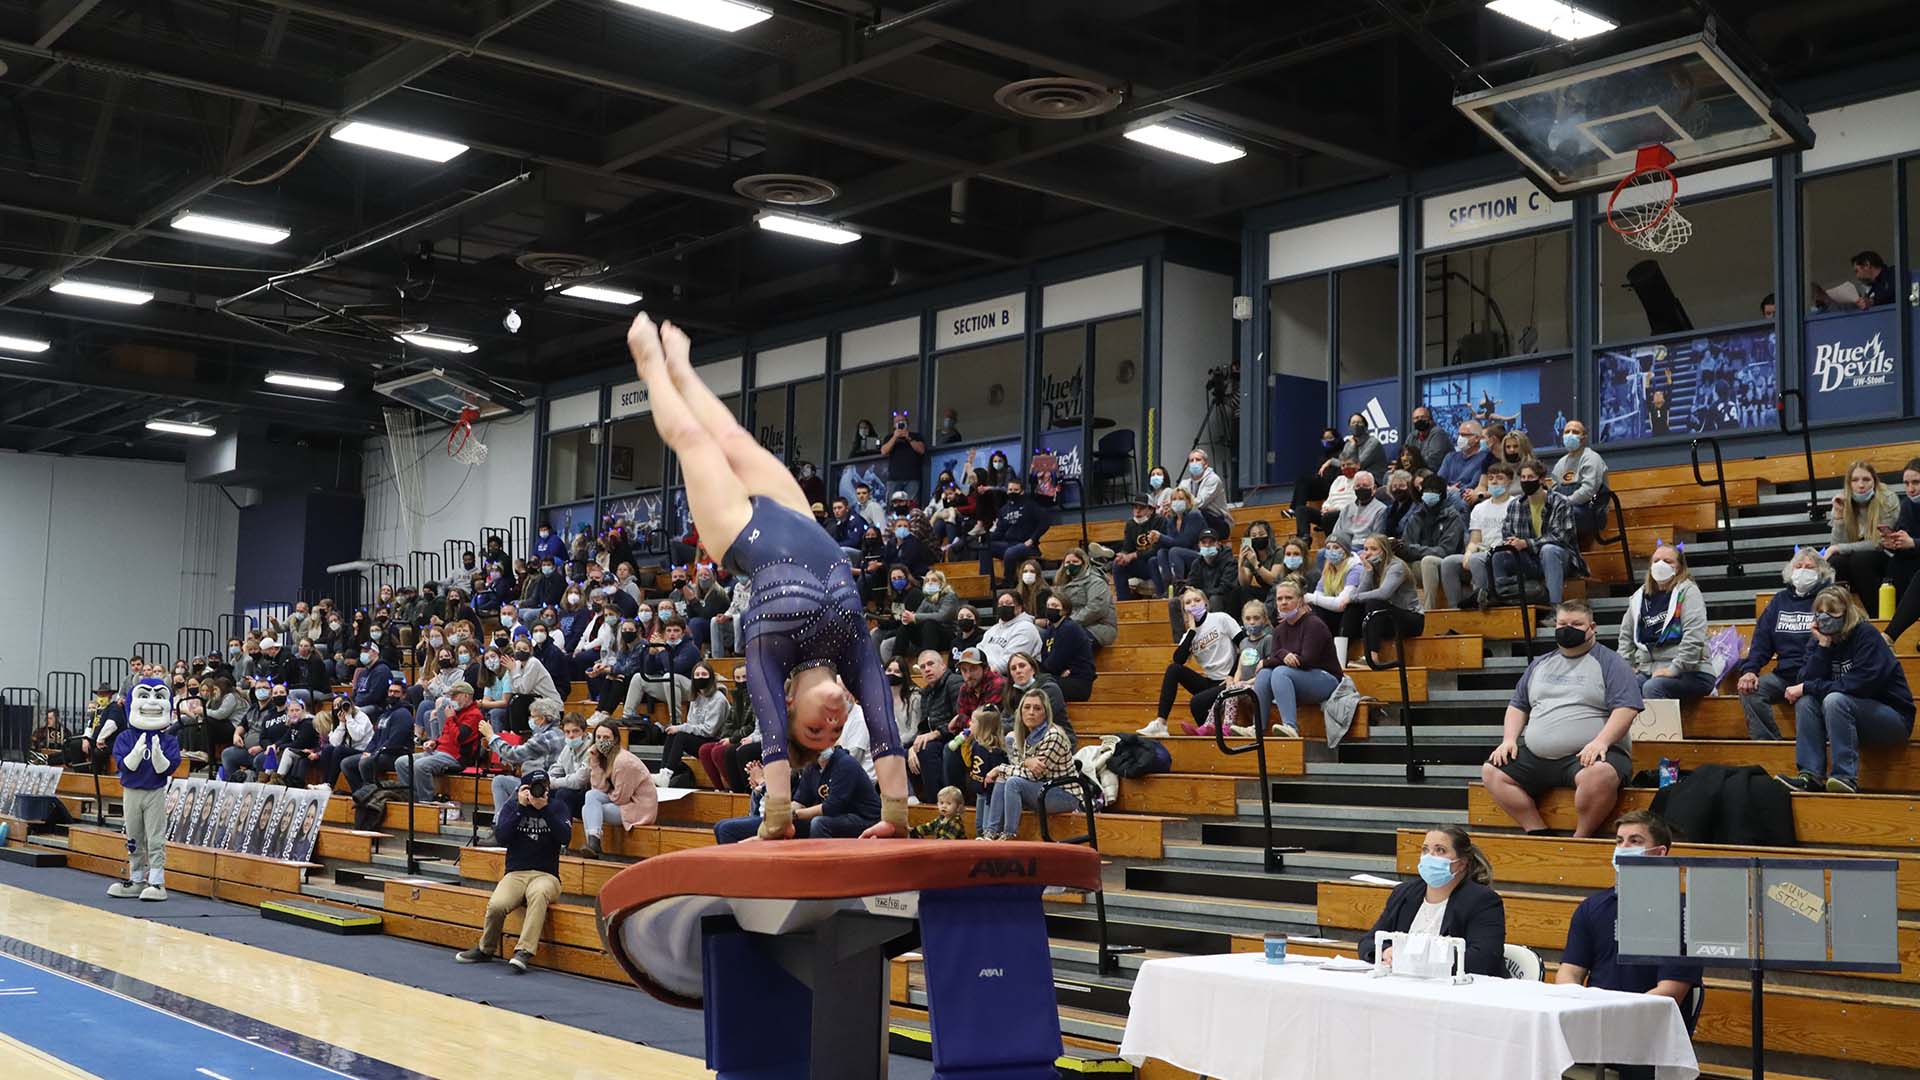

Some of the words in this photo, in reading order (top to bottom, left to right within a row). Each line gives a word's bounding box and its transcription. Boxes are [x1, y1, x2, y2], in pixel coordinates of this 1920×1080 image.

[1449, 196, 1517, 227] SECTION
[1528, 192, 1539, 211] C
[954, 312, 995, 335] SECTION
[1002, 310, 1009, 325] B
[1812, 341, 1864, 375] Blue
[1819, 350, 1894, 392] Devils
[622, 389, 648, 406] SECTION
[1776, 891, 1818, 916] STOUT
[1788, 884, 1808, 899] UW
